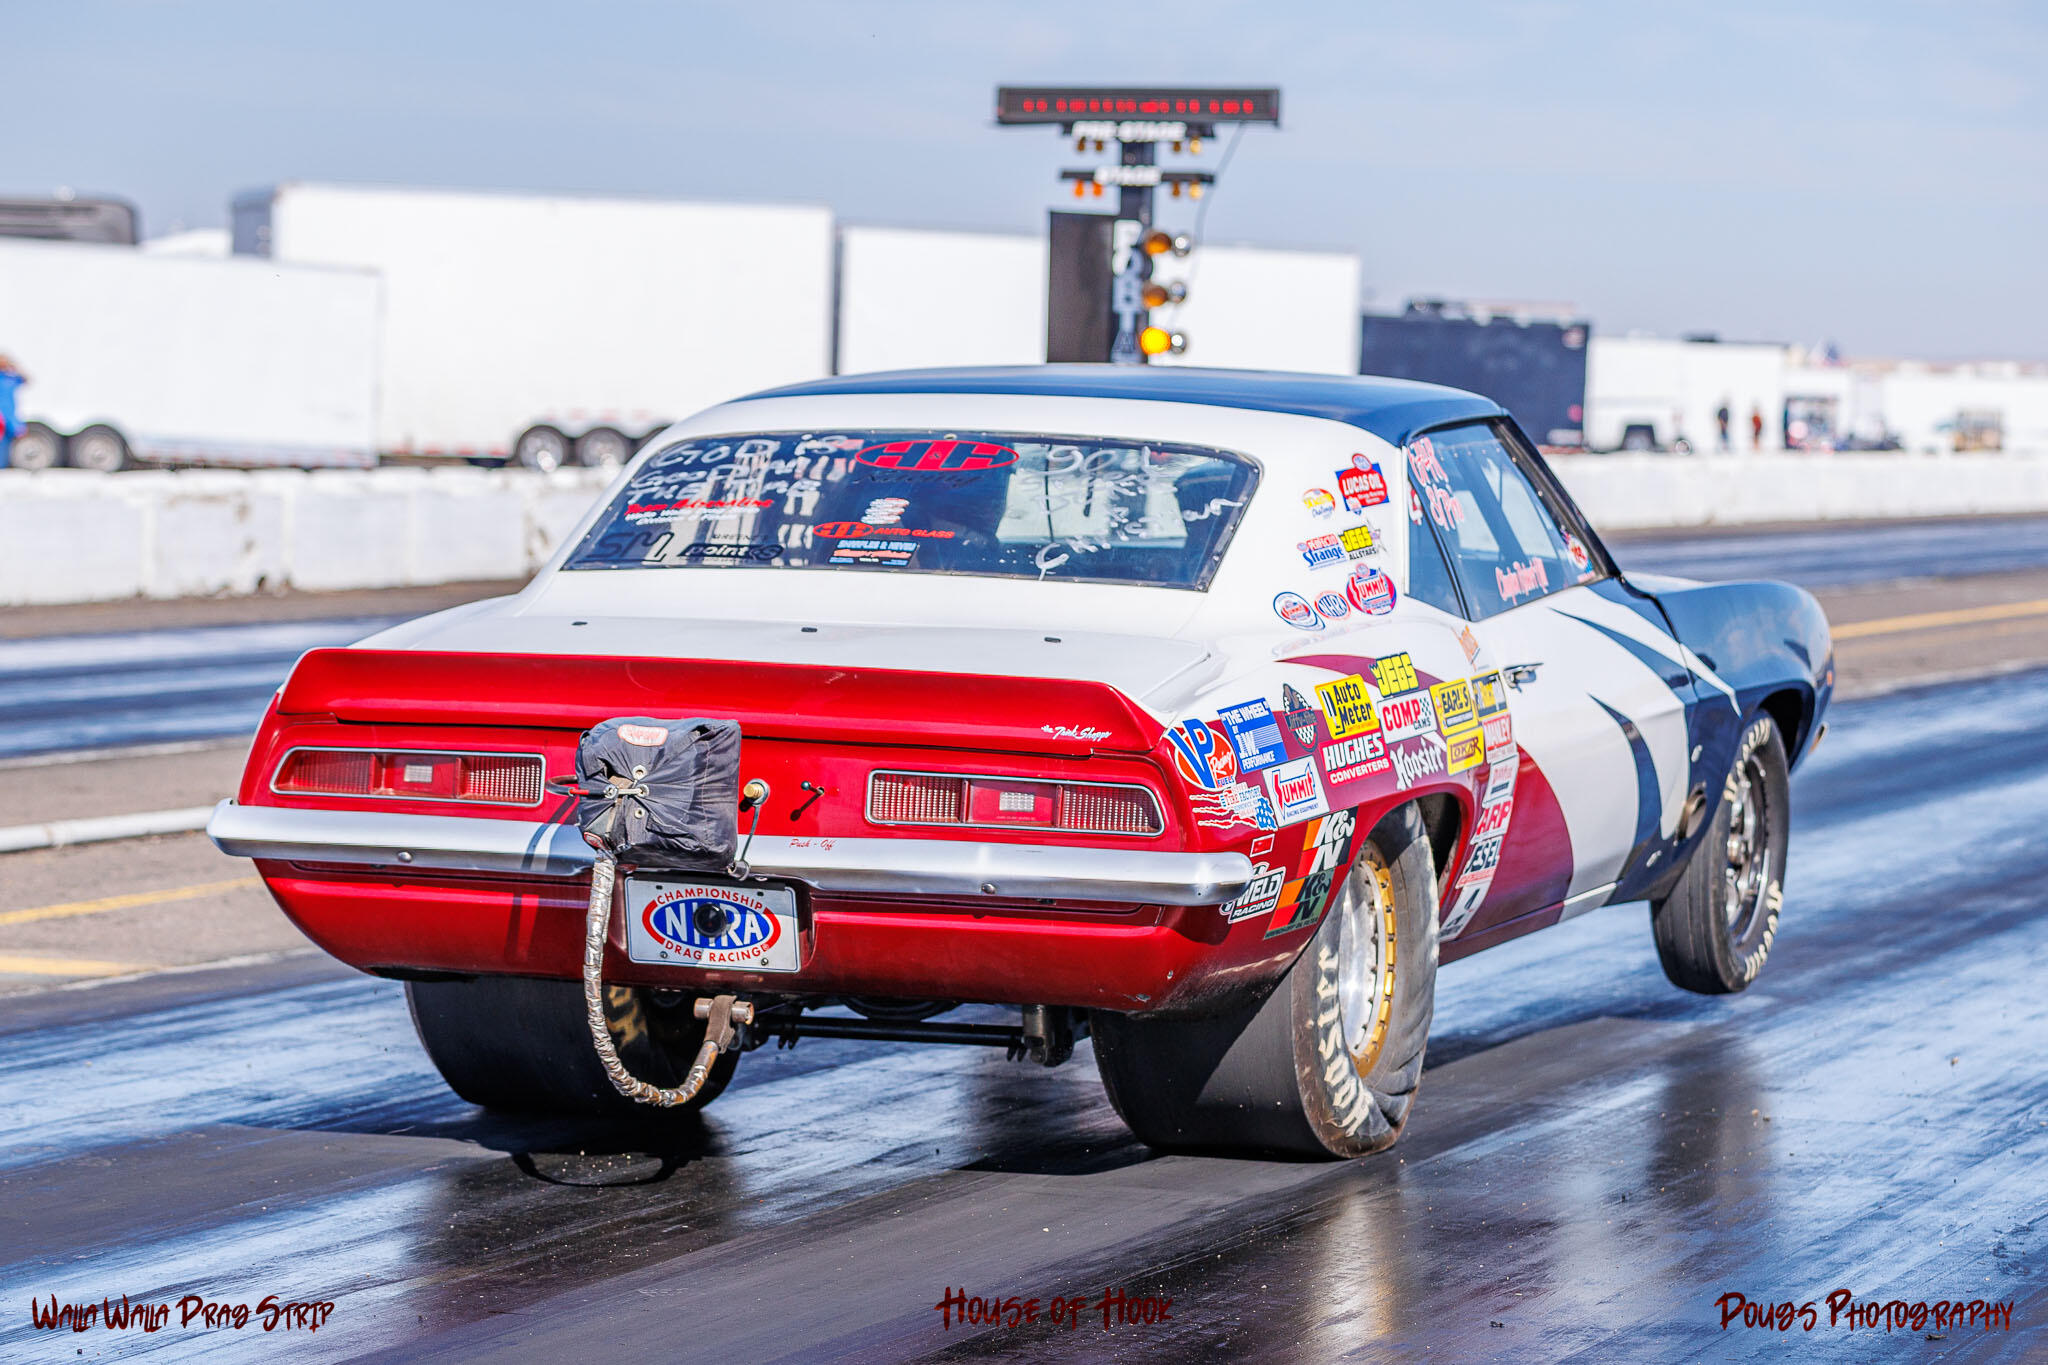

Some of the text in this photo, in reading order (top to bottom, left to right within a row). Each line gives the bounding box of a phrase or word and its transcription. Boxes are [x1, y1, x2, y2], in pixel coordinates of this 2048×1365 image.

[1342, 473, 1384, 496] LUCAS OIL
[911, 529, 956, 539] GLASS
[1341, 525, 1373, 552] JEGS
[1375, 652, 1419, 697] JEGS
[1334, 682, 1361, 706] Auto
[1340, 702, 1372, 728] Meter
[1382, 699, 1421, 732] COMP
[1413, 718, 1431, 730] CAMS
[1167, 718, 1214, 789] VP
[1210, 748, 1234, 775] Racing
[1322, 733, 1386, 772] HUGHES
[1217, 775, 1235, 787] FUELS
[1330, 759, 1389, 784] CONVERTERS
[1477, 800, 1511, 836] ARP
[656, 887, 763, 911] CHAMPIONSHIP
[1232, 898, 1275, 918] RACING
[664, 940, 762, 963] DRAG RACING
